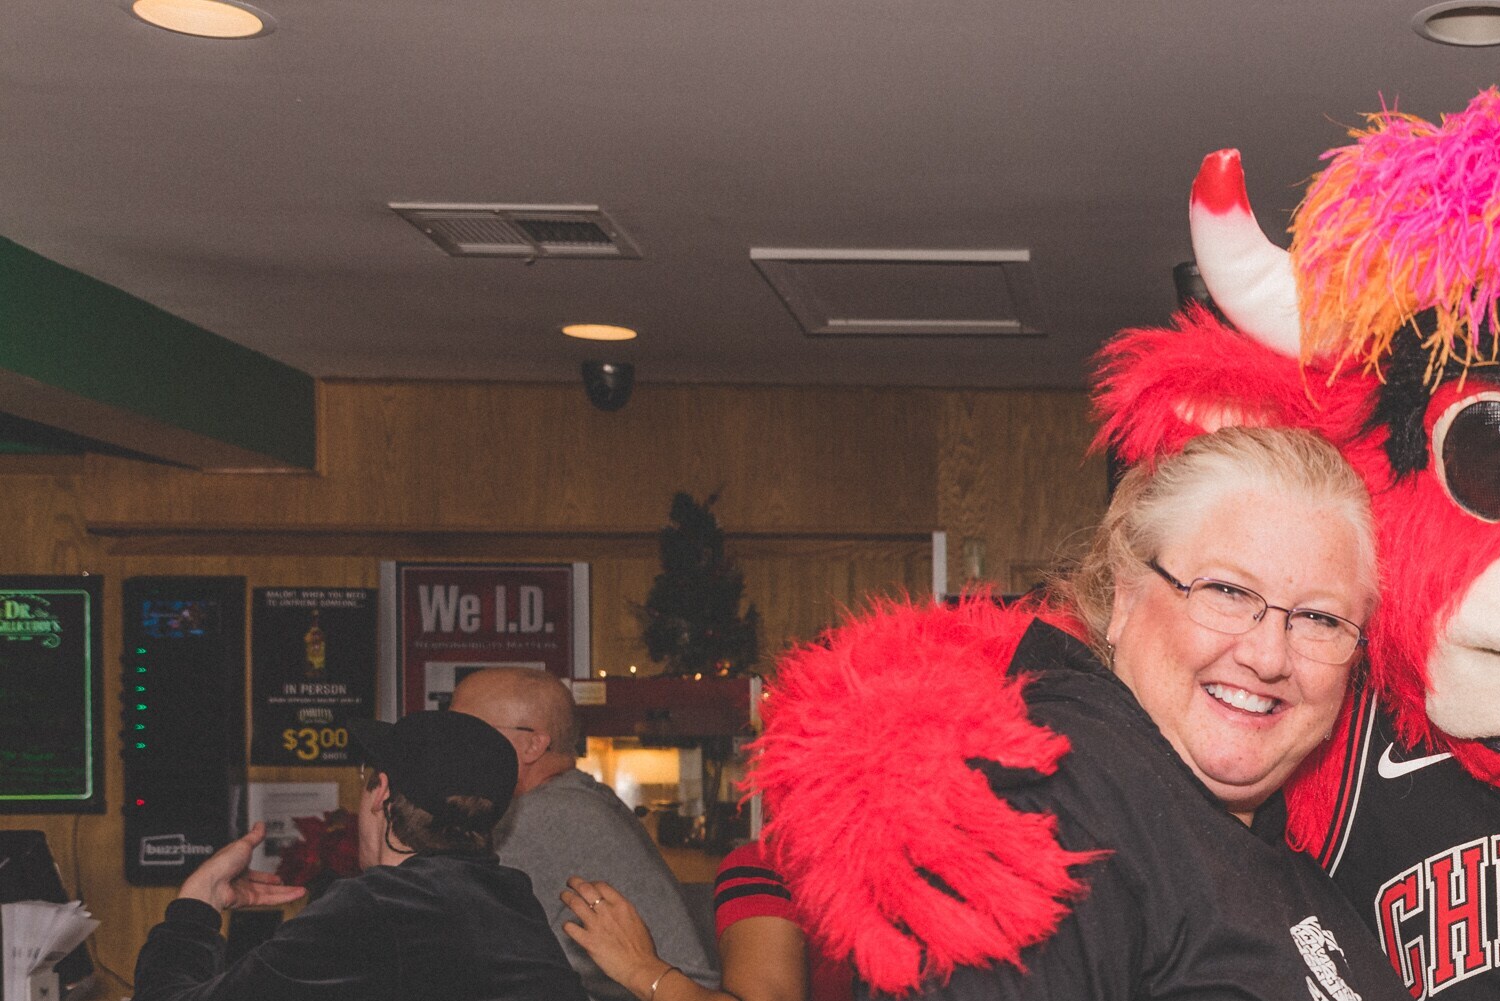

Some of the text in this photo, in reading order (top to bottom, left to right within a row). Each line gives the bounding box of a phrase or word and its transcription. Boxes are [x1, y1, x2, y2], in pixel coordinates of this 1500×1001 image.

[418, 585, 555, 633] We I.D.
[285, 684, 347, 695] IN PERSON
[144, 843, 214, 856] buzztime
